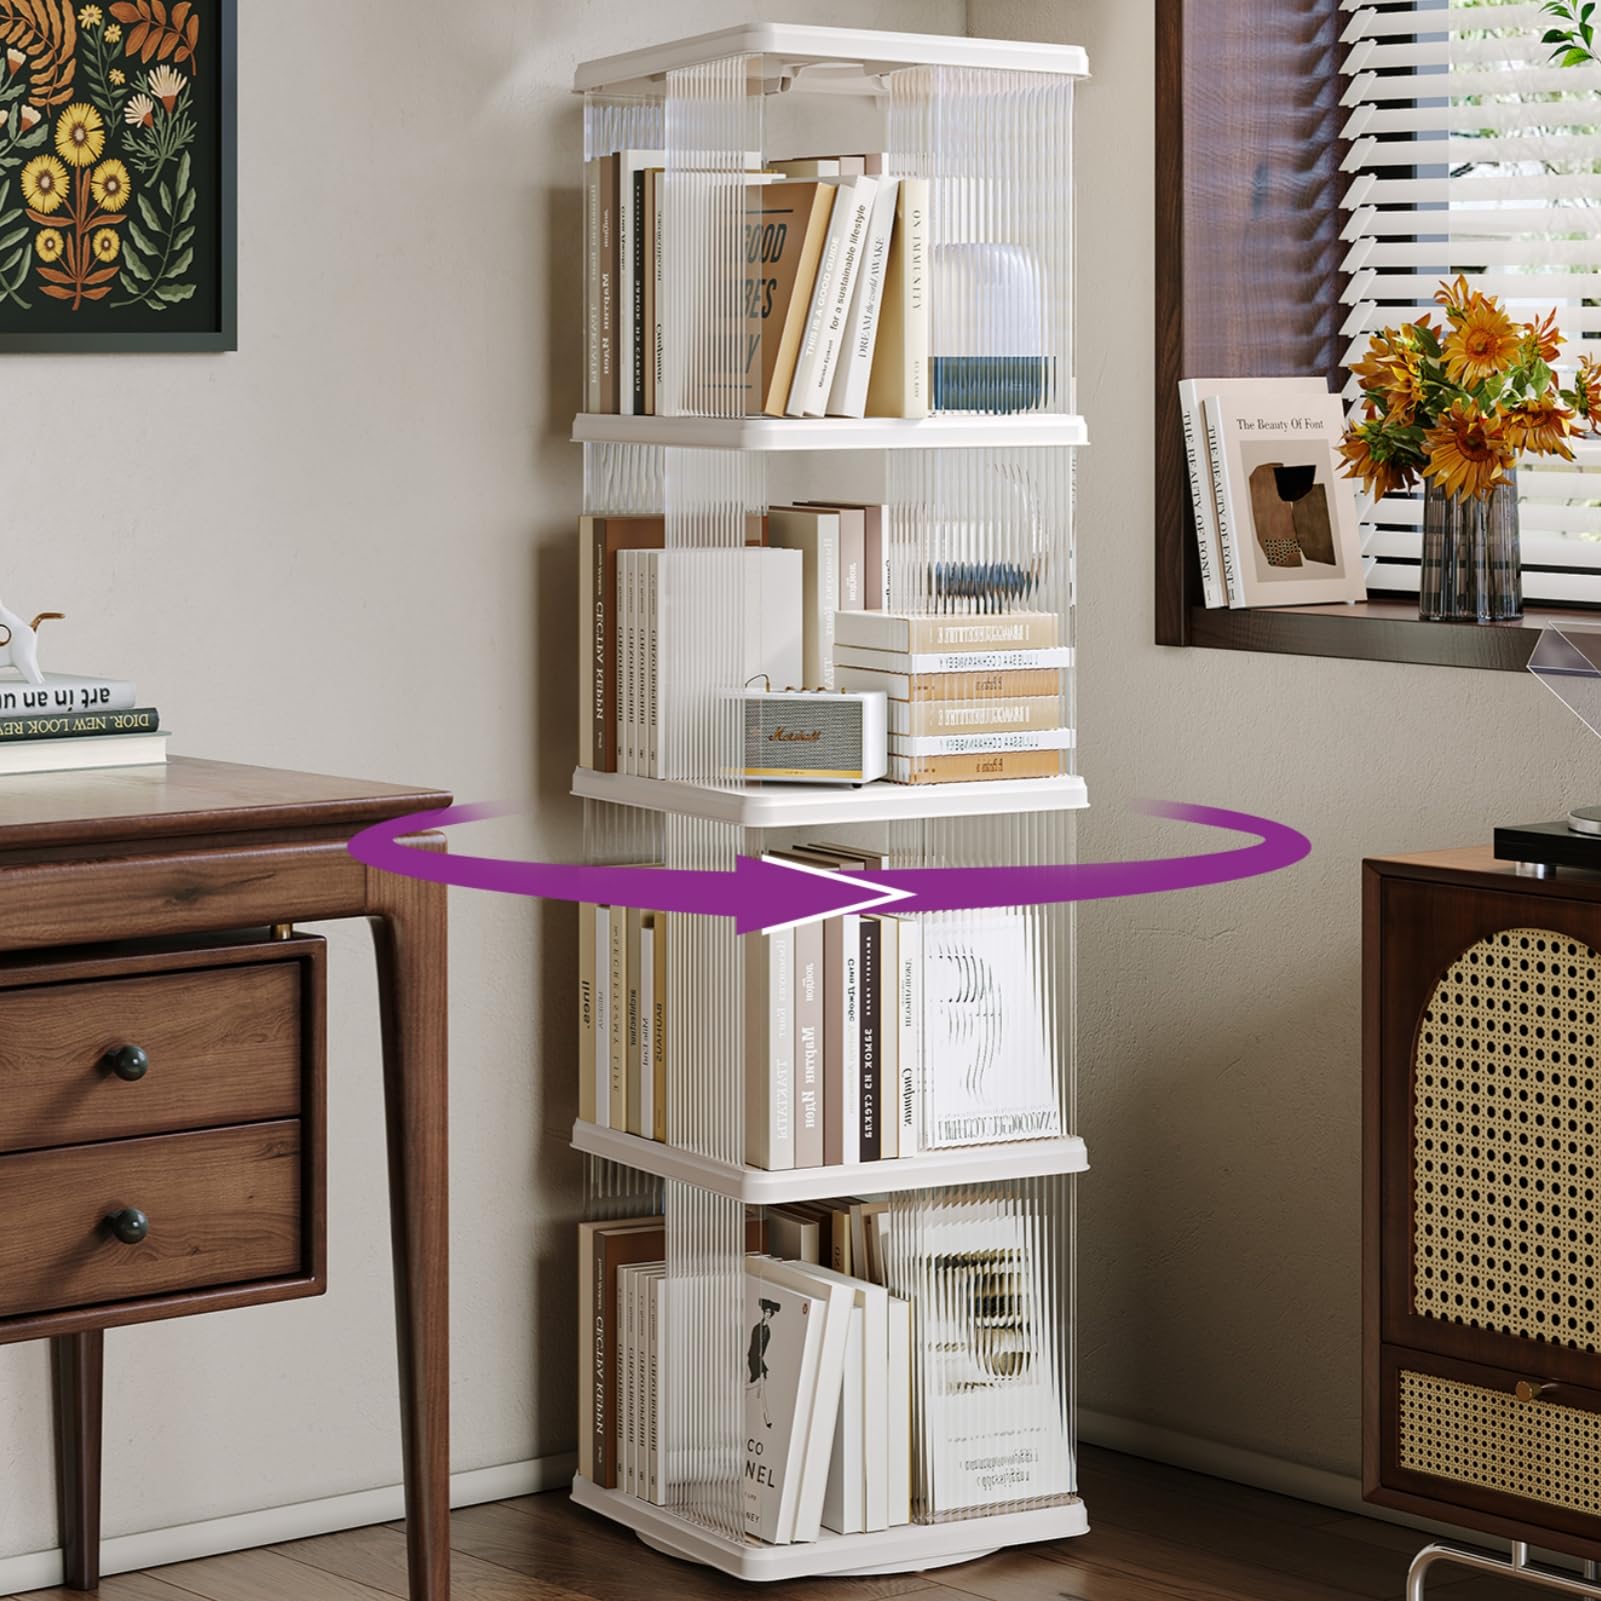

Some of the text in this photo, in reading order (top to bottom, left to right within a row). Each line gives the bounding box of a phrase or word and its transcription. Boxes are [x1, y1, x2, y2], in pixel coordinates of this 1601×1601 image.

[826, 236, 839, 271] GUIDE
[829, 203, 867, 331] for a sustainable lifestyle
[912, 209, 921, 311] ON IMMUNITY
[818, 272, 830, 307] GOOD
[857, 315, 873, 359] DREAM
[870, 237, 884, 277] AWAKE
[811, 319, 820, 331] IS
[806, 331, 819, 357] THIS
[1183, 410, 1194, 443] THE
[1236, 418, 1324, 433] The Beauty Of Font
[1188, 448, 1202, 509] BEAUTY
[1208, 425, 1235, 585] THE BEAUTY OF FONT
[1196, 514, 1206, 536] OF
[1199, 540, 1211, 582] FONT
[0, 688, 110, 711] art in an u
[28, 719, 69, 733] LOOK
[72, 715, 107, 731] NEW
[109, 713, 150, 729] DIOR.
[768, 726, 821, 742] Marshall
[747, 1438, 764, 1456] CO
[745, 1460, 775, 1488] NEL
